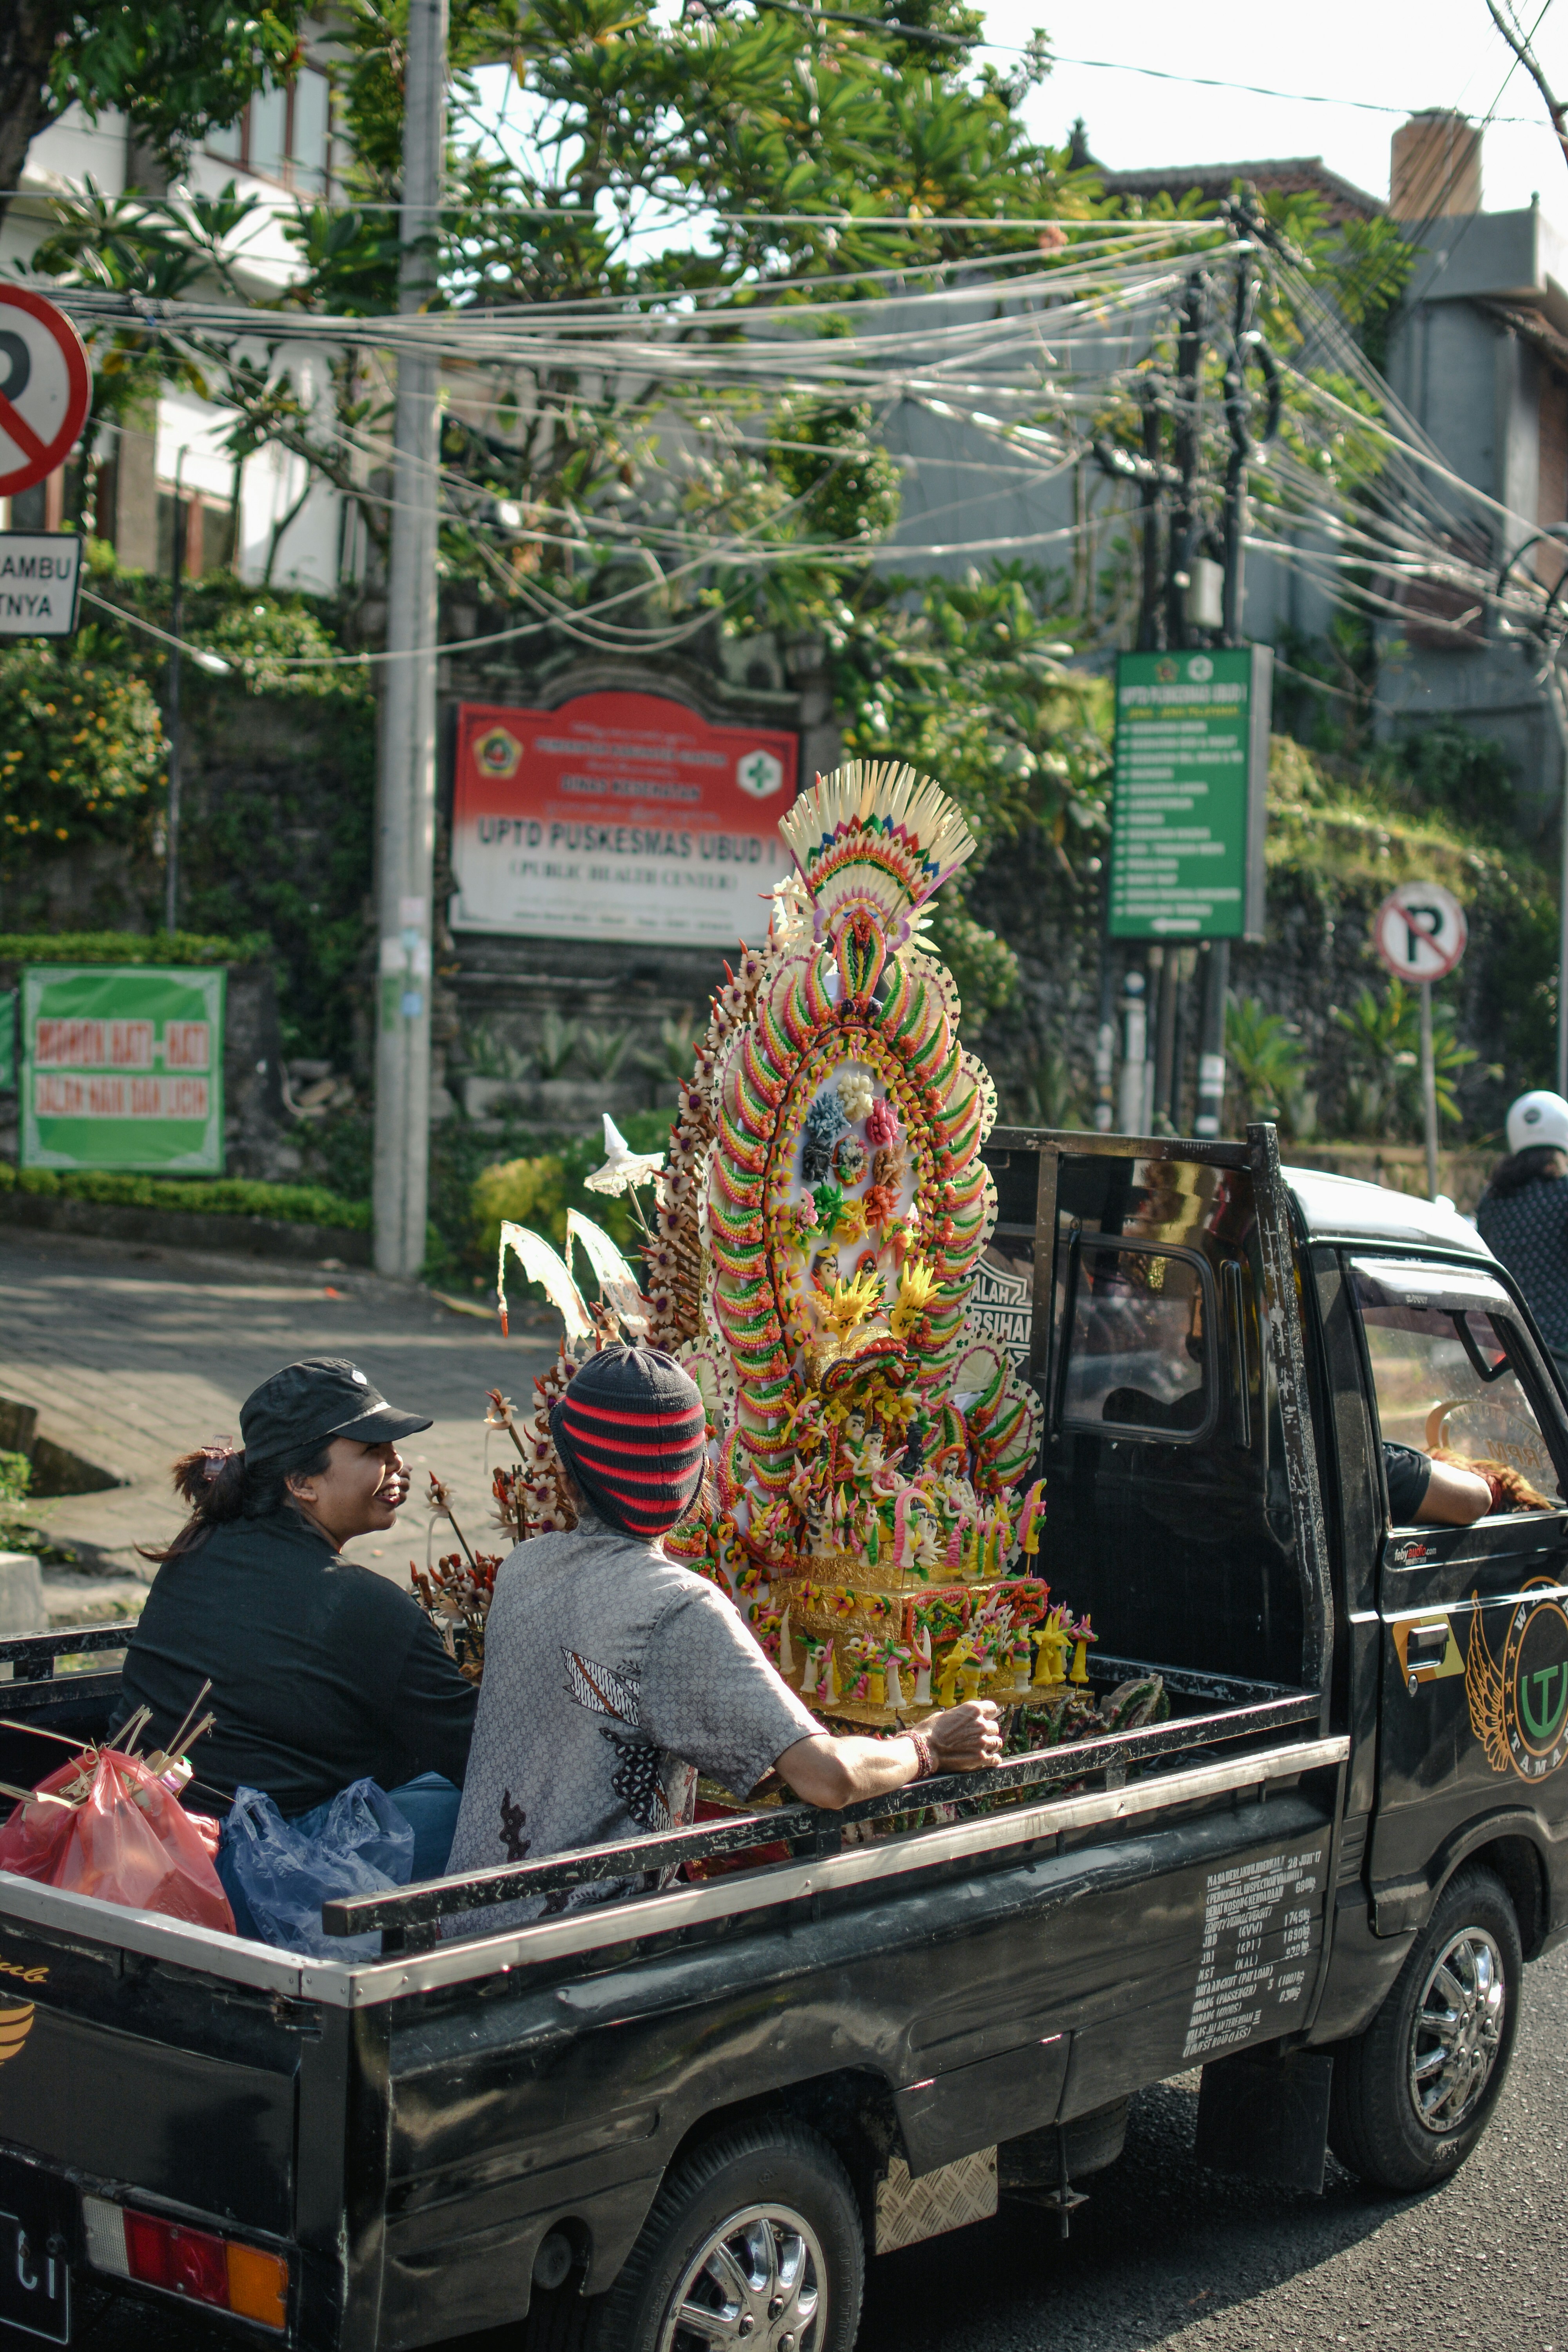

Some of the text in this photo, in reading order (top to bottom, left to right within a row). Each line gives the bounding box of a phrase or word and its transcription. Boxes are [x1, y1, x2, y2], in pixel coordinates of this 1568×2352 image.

[0, 555, 71, 579] AMBU
[479, 818, 776, 864] UPTD PUSKESMAS UBUD I
[970, 1310, 1032, 1343] RSIHA
[1510, 1726, 1568, 1776] TAMA
